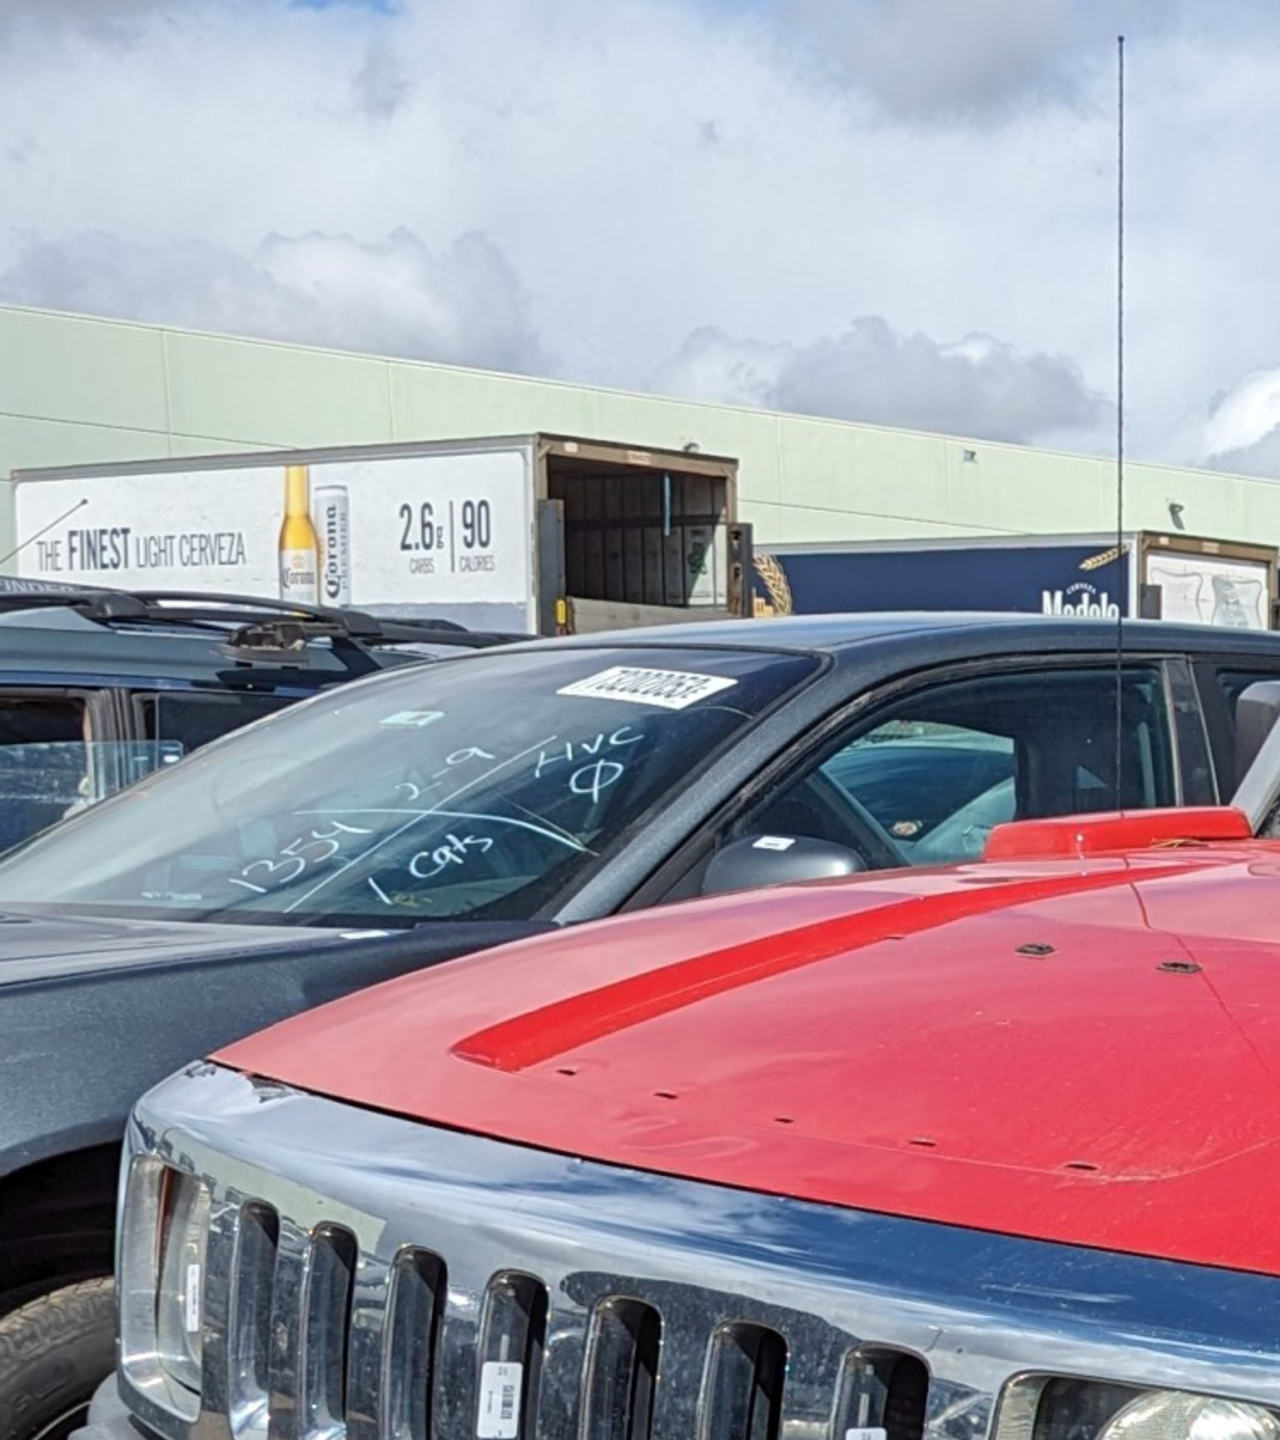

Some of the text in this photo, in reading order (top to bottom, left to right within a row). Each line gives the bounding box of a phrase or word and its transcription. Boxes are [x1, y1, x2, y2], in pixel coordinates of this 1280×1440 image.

[462, 499, 490, 549] 90
[36, 527, 247, 571] THE FINEST LIGHT CERVEZA
[325, 504, 342, 599] Corona
[0, 579, 75, 593] INDER
[1042, 590, 1119, 617] Modelo
[229, 820, 377, 893] 1354
